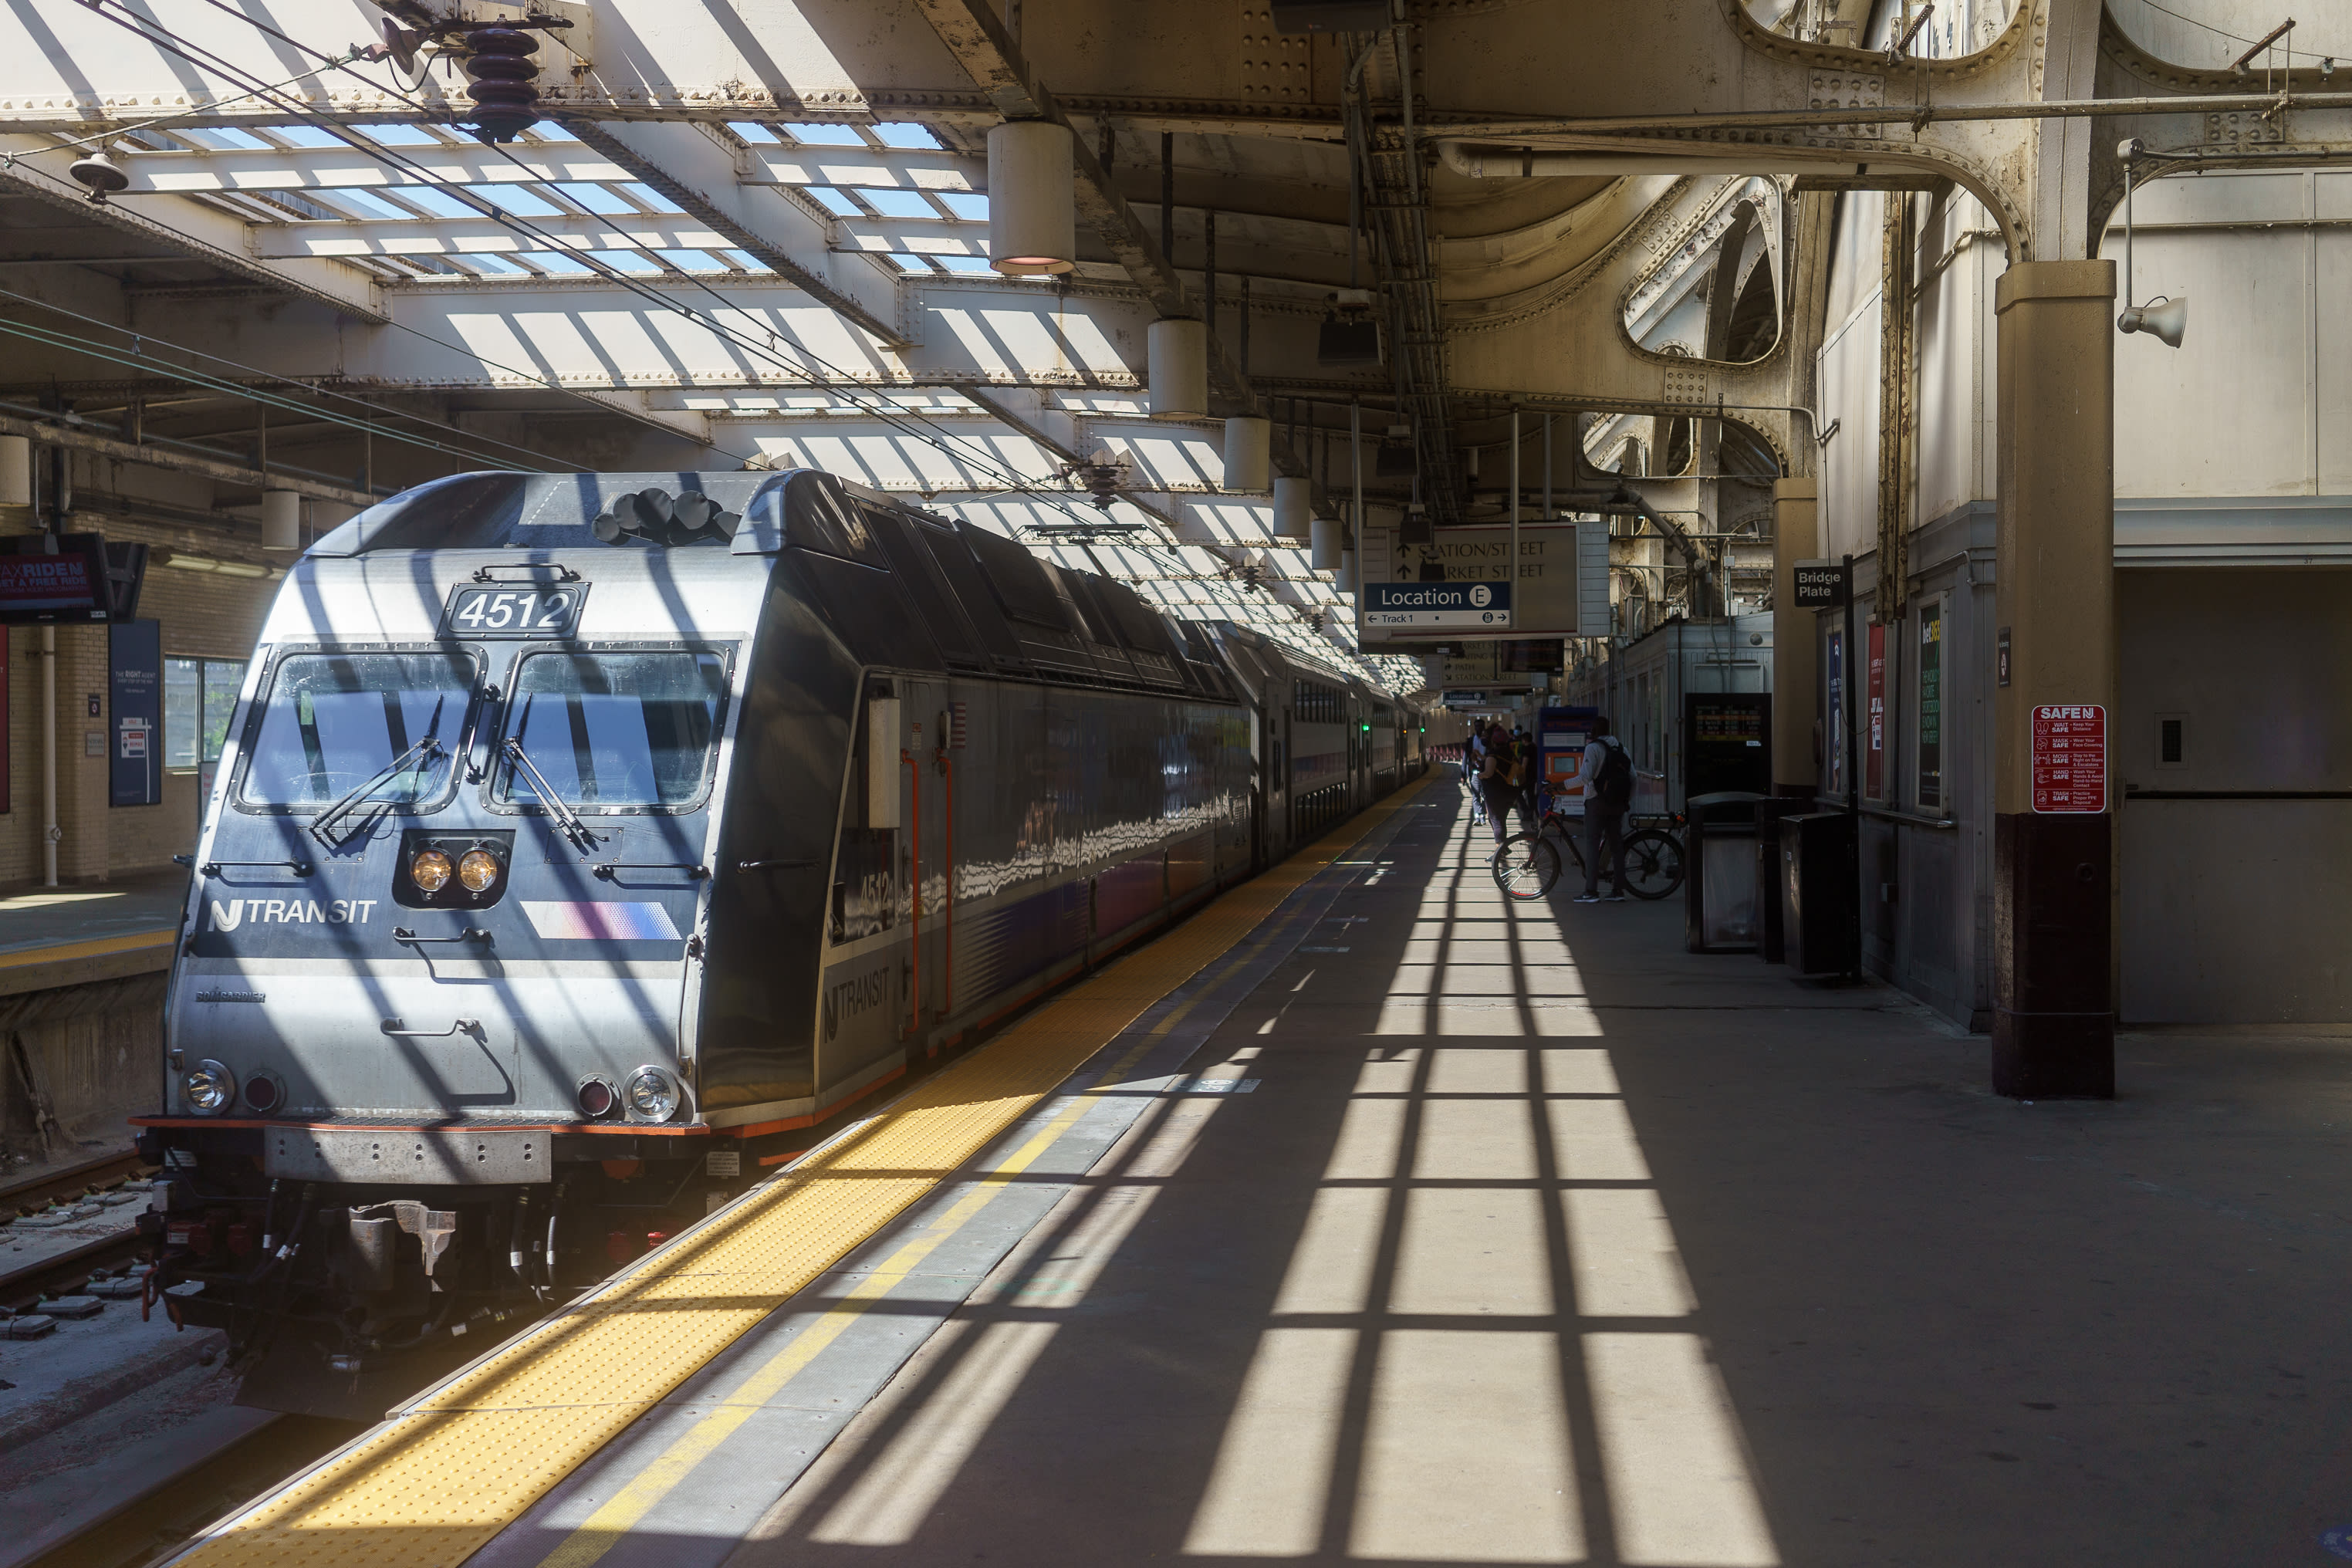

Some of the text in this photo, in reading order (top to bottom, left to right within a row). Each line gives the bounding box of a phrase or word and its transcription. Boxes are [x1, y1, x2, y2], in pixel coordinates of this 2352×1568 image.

[1492, 565, 1545, 578] STEET
[1799, 571, 1840, 584] Bridge
[60, 576, 86, 585] RIDE
[1382, 588, 1462, 605] Location
[1799, 586, 1831, 597] Plate
[458, 593, 569, 628] 4512
[1381, 614, 1407, 623] Track
[1922, 619, 1940, 644] bet365
[125, 670, 140, 678] RIGHT
[2040, 707, 2081, 719] SAFE
[861, 870, 889, 913] 4512
[207, 899, 377, 932] NJ TRANSIT
[840, 966, 890, 1019] TRANSIT
